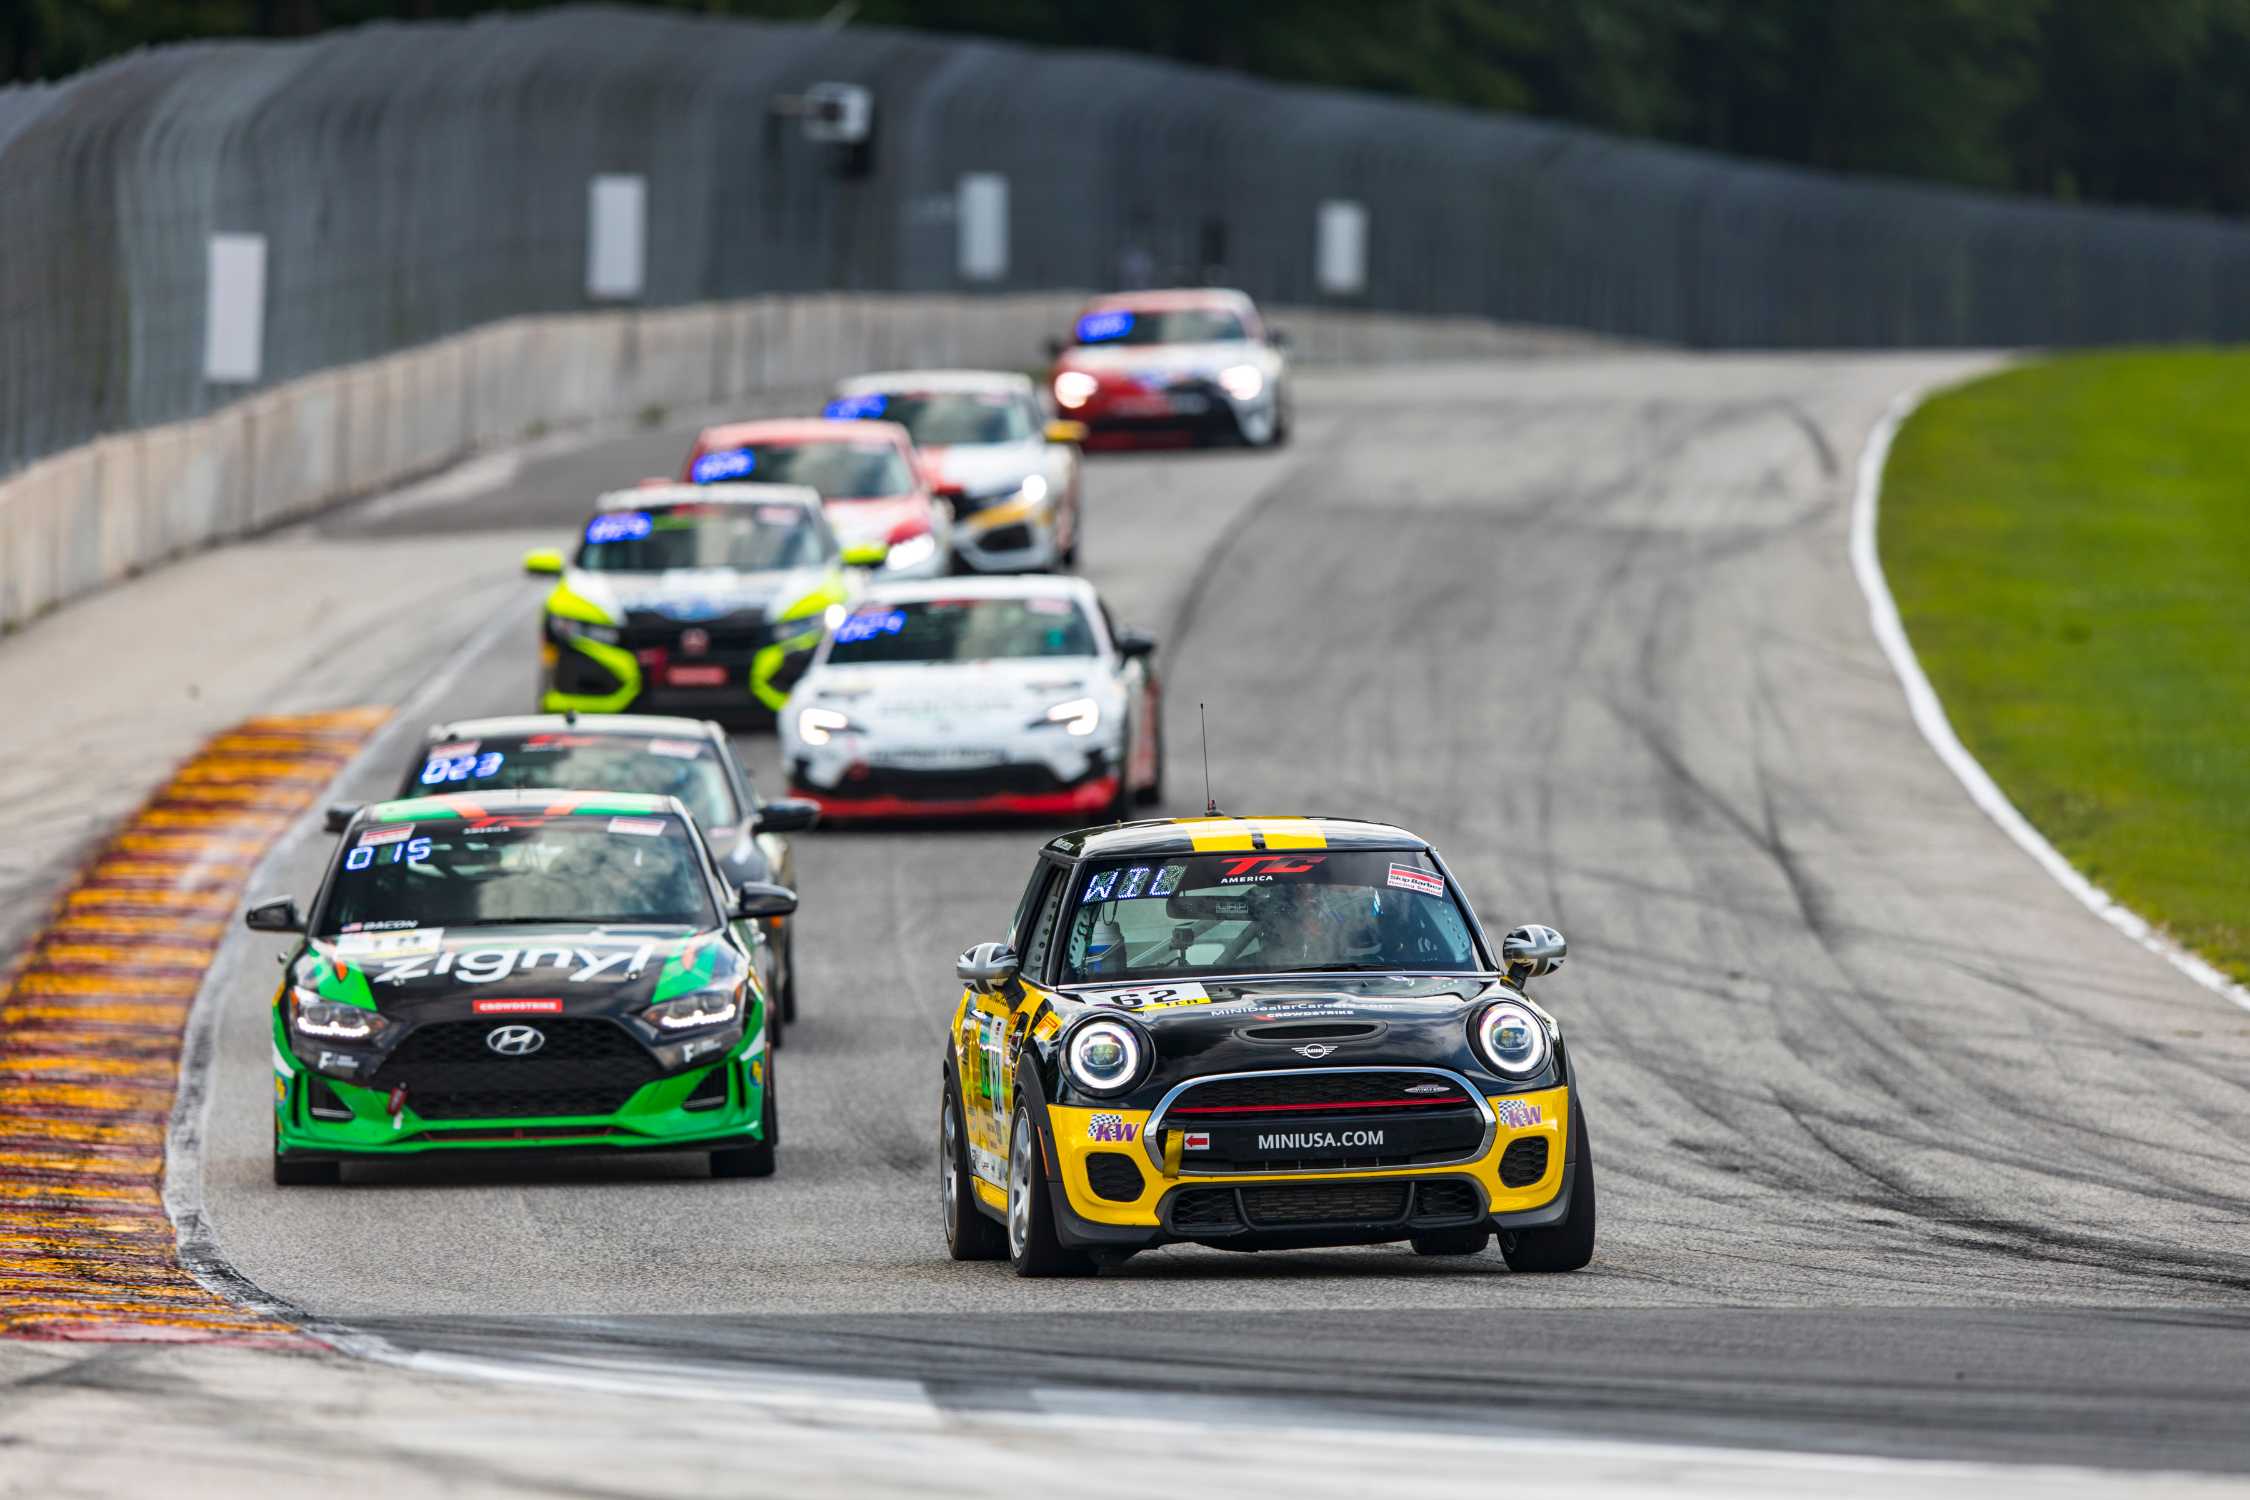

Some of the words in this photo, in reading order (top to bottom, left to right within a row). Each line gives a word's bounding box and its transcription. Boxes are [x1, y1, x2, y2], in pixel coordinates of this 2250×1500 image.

[421, 752, 504, 784] 023
[1220, 856, 1328, 876] TC
[1220, 875, 1273, 884] AMERICA
[1411, 878, 1442, 891] Barber
[373, 943, 655, 983] zignyl
[479, 1001, 557, 1011] CROWDSTRIKE
[1111, 989, 1180, 1008] 62
[1266, 1010, 1355, 1018] CROWDSTRIKE
[1508, 1103, 1542, 1129] KW
[1094, 1123, 1140, 1142] KW
[1258, 1130, 1384, 1150] MINIUSA.COM
